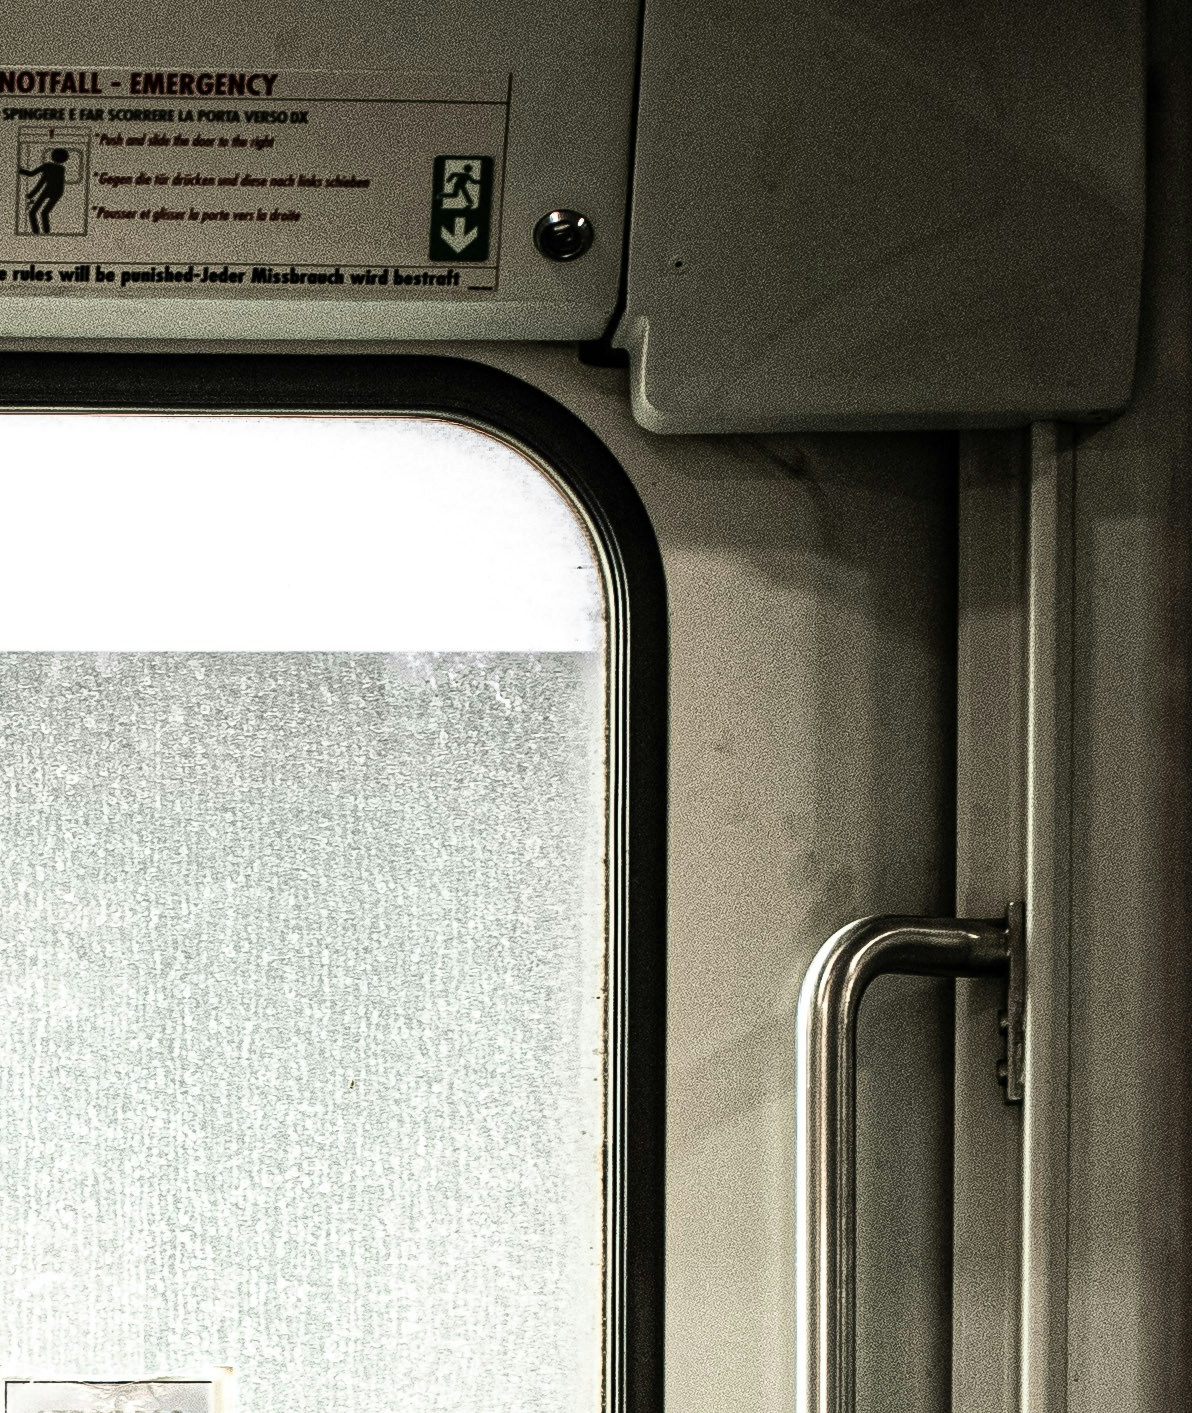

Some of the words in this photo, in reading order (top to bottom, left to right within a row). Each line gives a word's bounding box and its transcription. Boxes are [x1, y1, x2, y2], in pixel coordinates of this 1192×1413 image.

[129, 72, 278, 95] EMERGENCY
[2, 107, 66, 121] SPINGERE
[68, 107, 77, 121] E
[78, 108, 105, 121] FAR
[107, 108, 175, 122] SCORRERE
[177, 109, 195, 122] LA
[196, 109, 241, 123] PORTA
[243, 109, 289, 124] VERSO
[288, 110, 310, 124] DX
[12, 264, 53, 281] rules
[59, 264, 91, 282] will
[95, 264, 115, 282] be
[250, 266, 345, 284] Missbrauch
[349, 267, 390, 285] wird
[392, 267, 461, 286] bestraft
